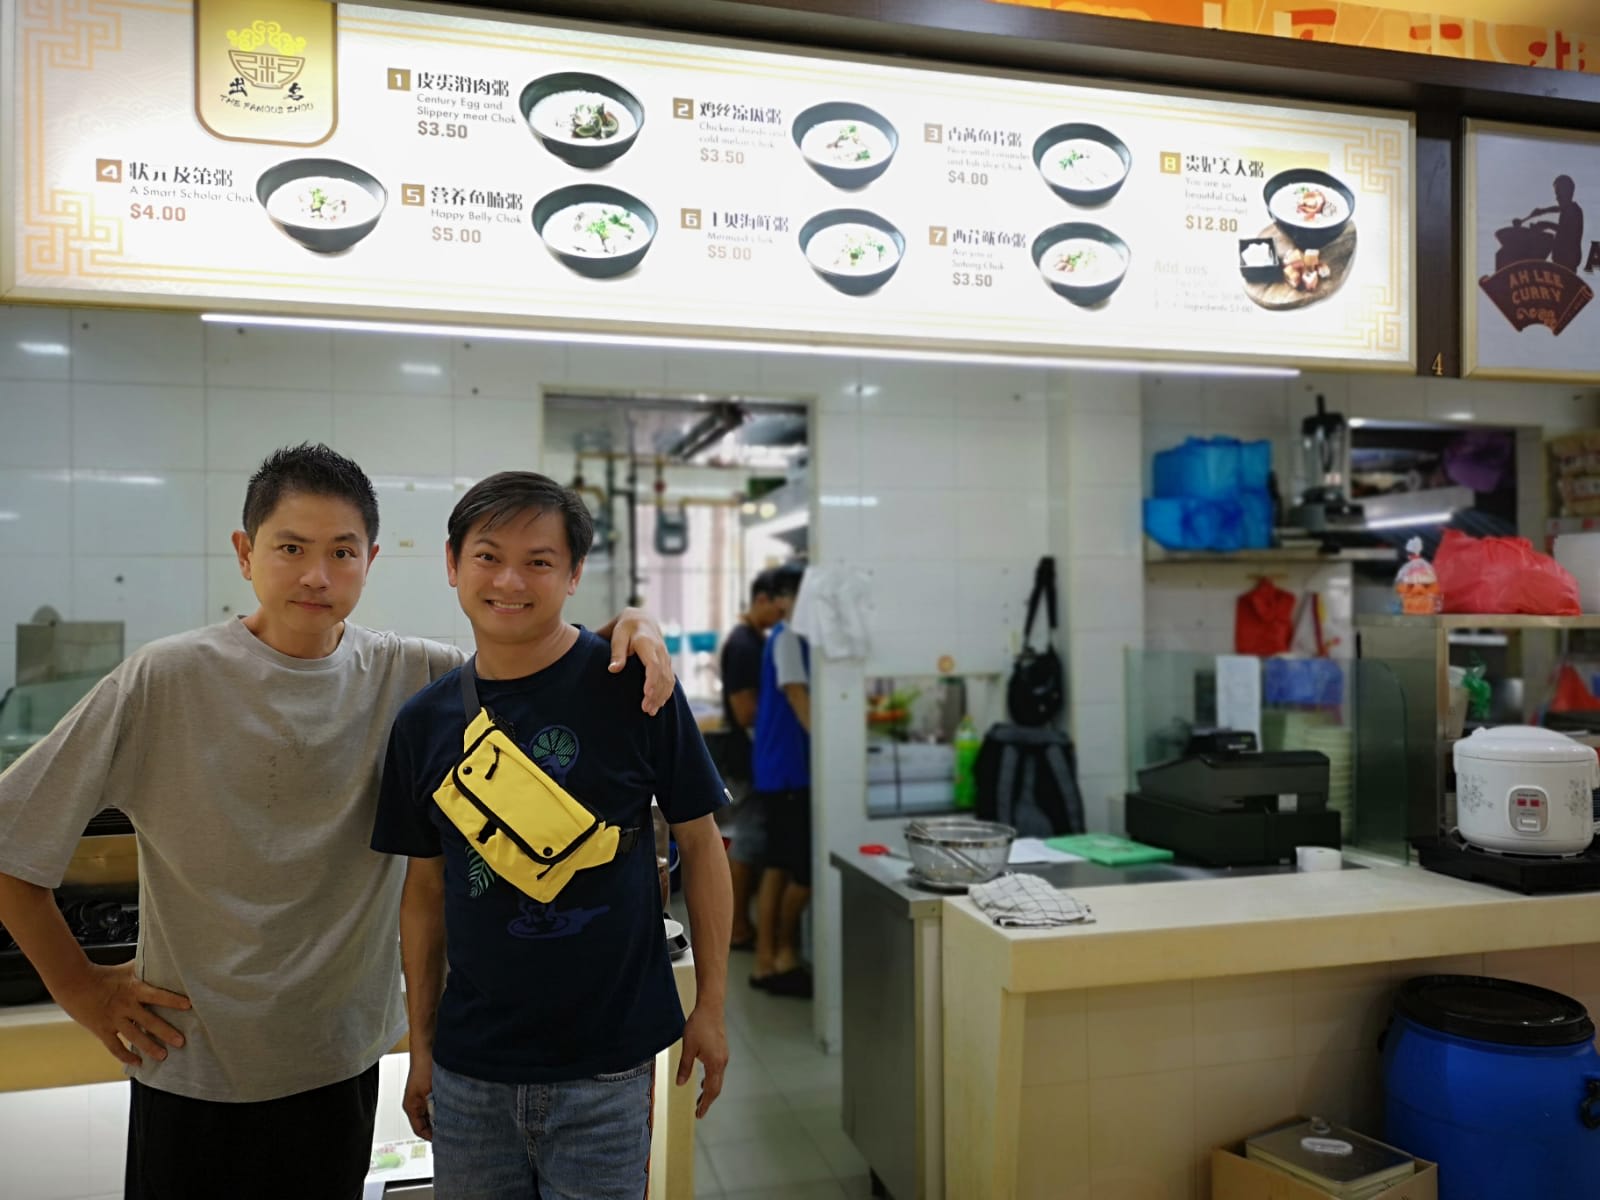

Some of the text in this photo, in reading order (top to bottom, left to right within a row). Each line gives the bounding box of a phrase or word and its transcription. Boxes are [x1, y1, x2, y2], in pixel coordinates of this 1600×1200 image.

[220, 94, 240, 107] THE
[244, 101, 283, 114] FAMOUS
[417, 93, 503, 110] Century Egg and
[417, 106, 517, 124] Slippery meat Chok
[417, 120, 468, 139] $3.50
[700, 147, 745, 164] $3.50
[129, 161, 233, 187] 状元及第粥
[948, 169, 989, 186] $4.00
[129, 185, 254, 203] A Smart Scholar Chok
[1225, 193, 1247, 203] Chok
[130, 202, 186, 221] $4.00
[431, 208, 522, 223] Happy Belly Chok
[1185, 214, 1238, 233] $12.80
[432, 226, 481, 243] $5.00
[707, 244, 752, 260] $5.00
[952, 272, 993, 287] $3.50
[1509, 269, 1564, 289] AH LEE
[1511, 286, 1562, 304] CURRY
[1431, 352, 1444, 376] 4
